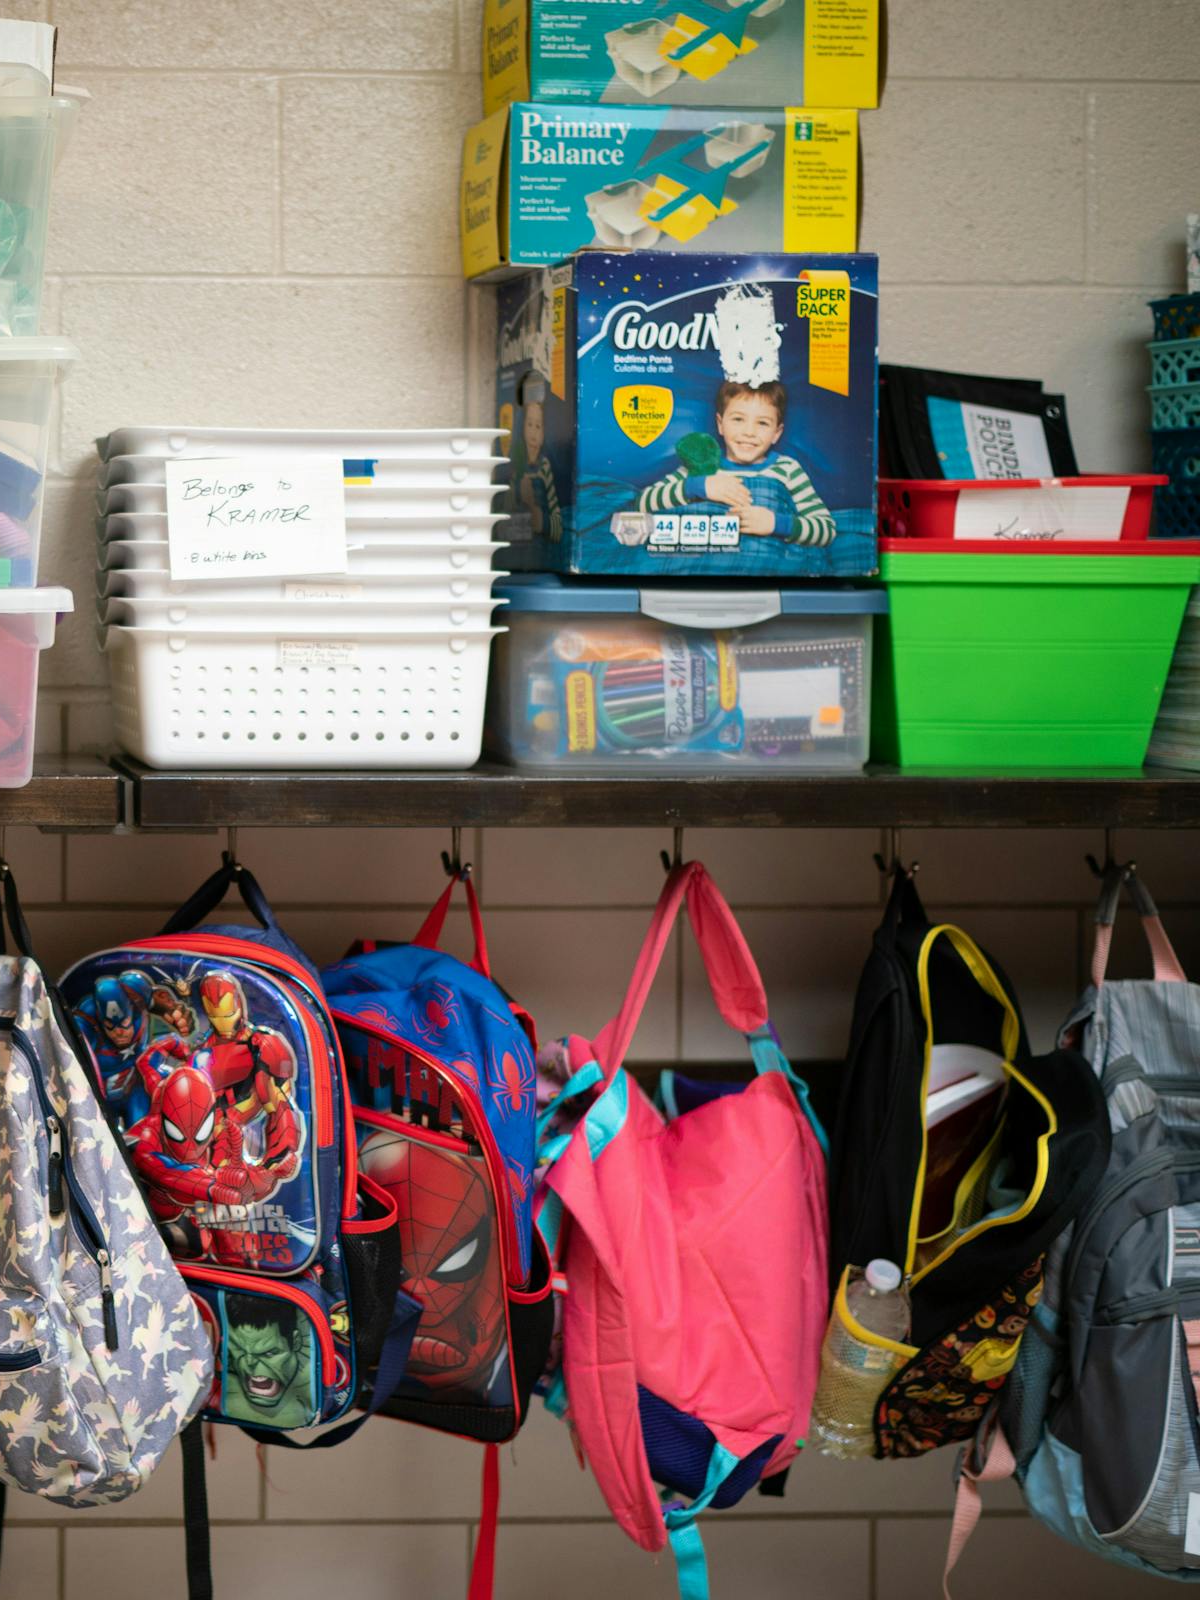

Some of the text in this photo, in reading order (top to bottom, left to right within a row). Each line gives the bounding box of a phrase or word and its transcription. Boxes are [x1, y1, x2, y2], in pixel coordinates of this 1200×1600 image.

[520, 112, 630, 145] Primary
[520, 139, 625, 165] Balance
[520, 175, 549, 183] Measure
[520, 197, 544, 205] Perfect
[799, 287, 846, 301] SUPER
[799, 303, 838, 316] PACK
[614, 311, 784, 351] GoodNs
[613, 354, 672, 364] Bedtime Pants
[613, 364, 674, 373] Culottes de nuit
[622, 411, 665, 420] Protection
[994, 418, 1022, 479] BINDE
[182, 477, 292, 501] Belongs to
[206, 500, 312, 528] KRAMER
[655, 521, 674, 531] 44
[684, 521, 706, 532] 4-8
[711, 521, 738, 532] S-M
[203, 550, 237, 564] white
[242, 550, 267, 561] bins
